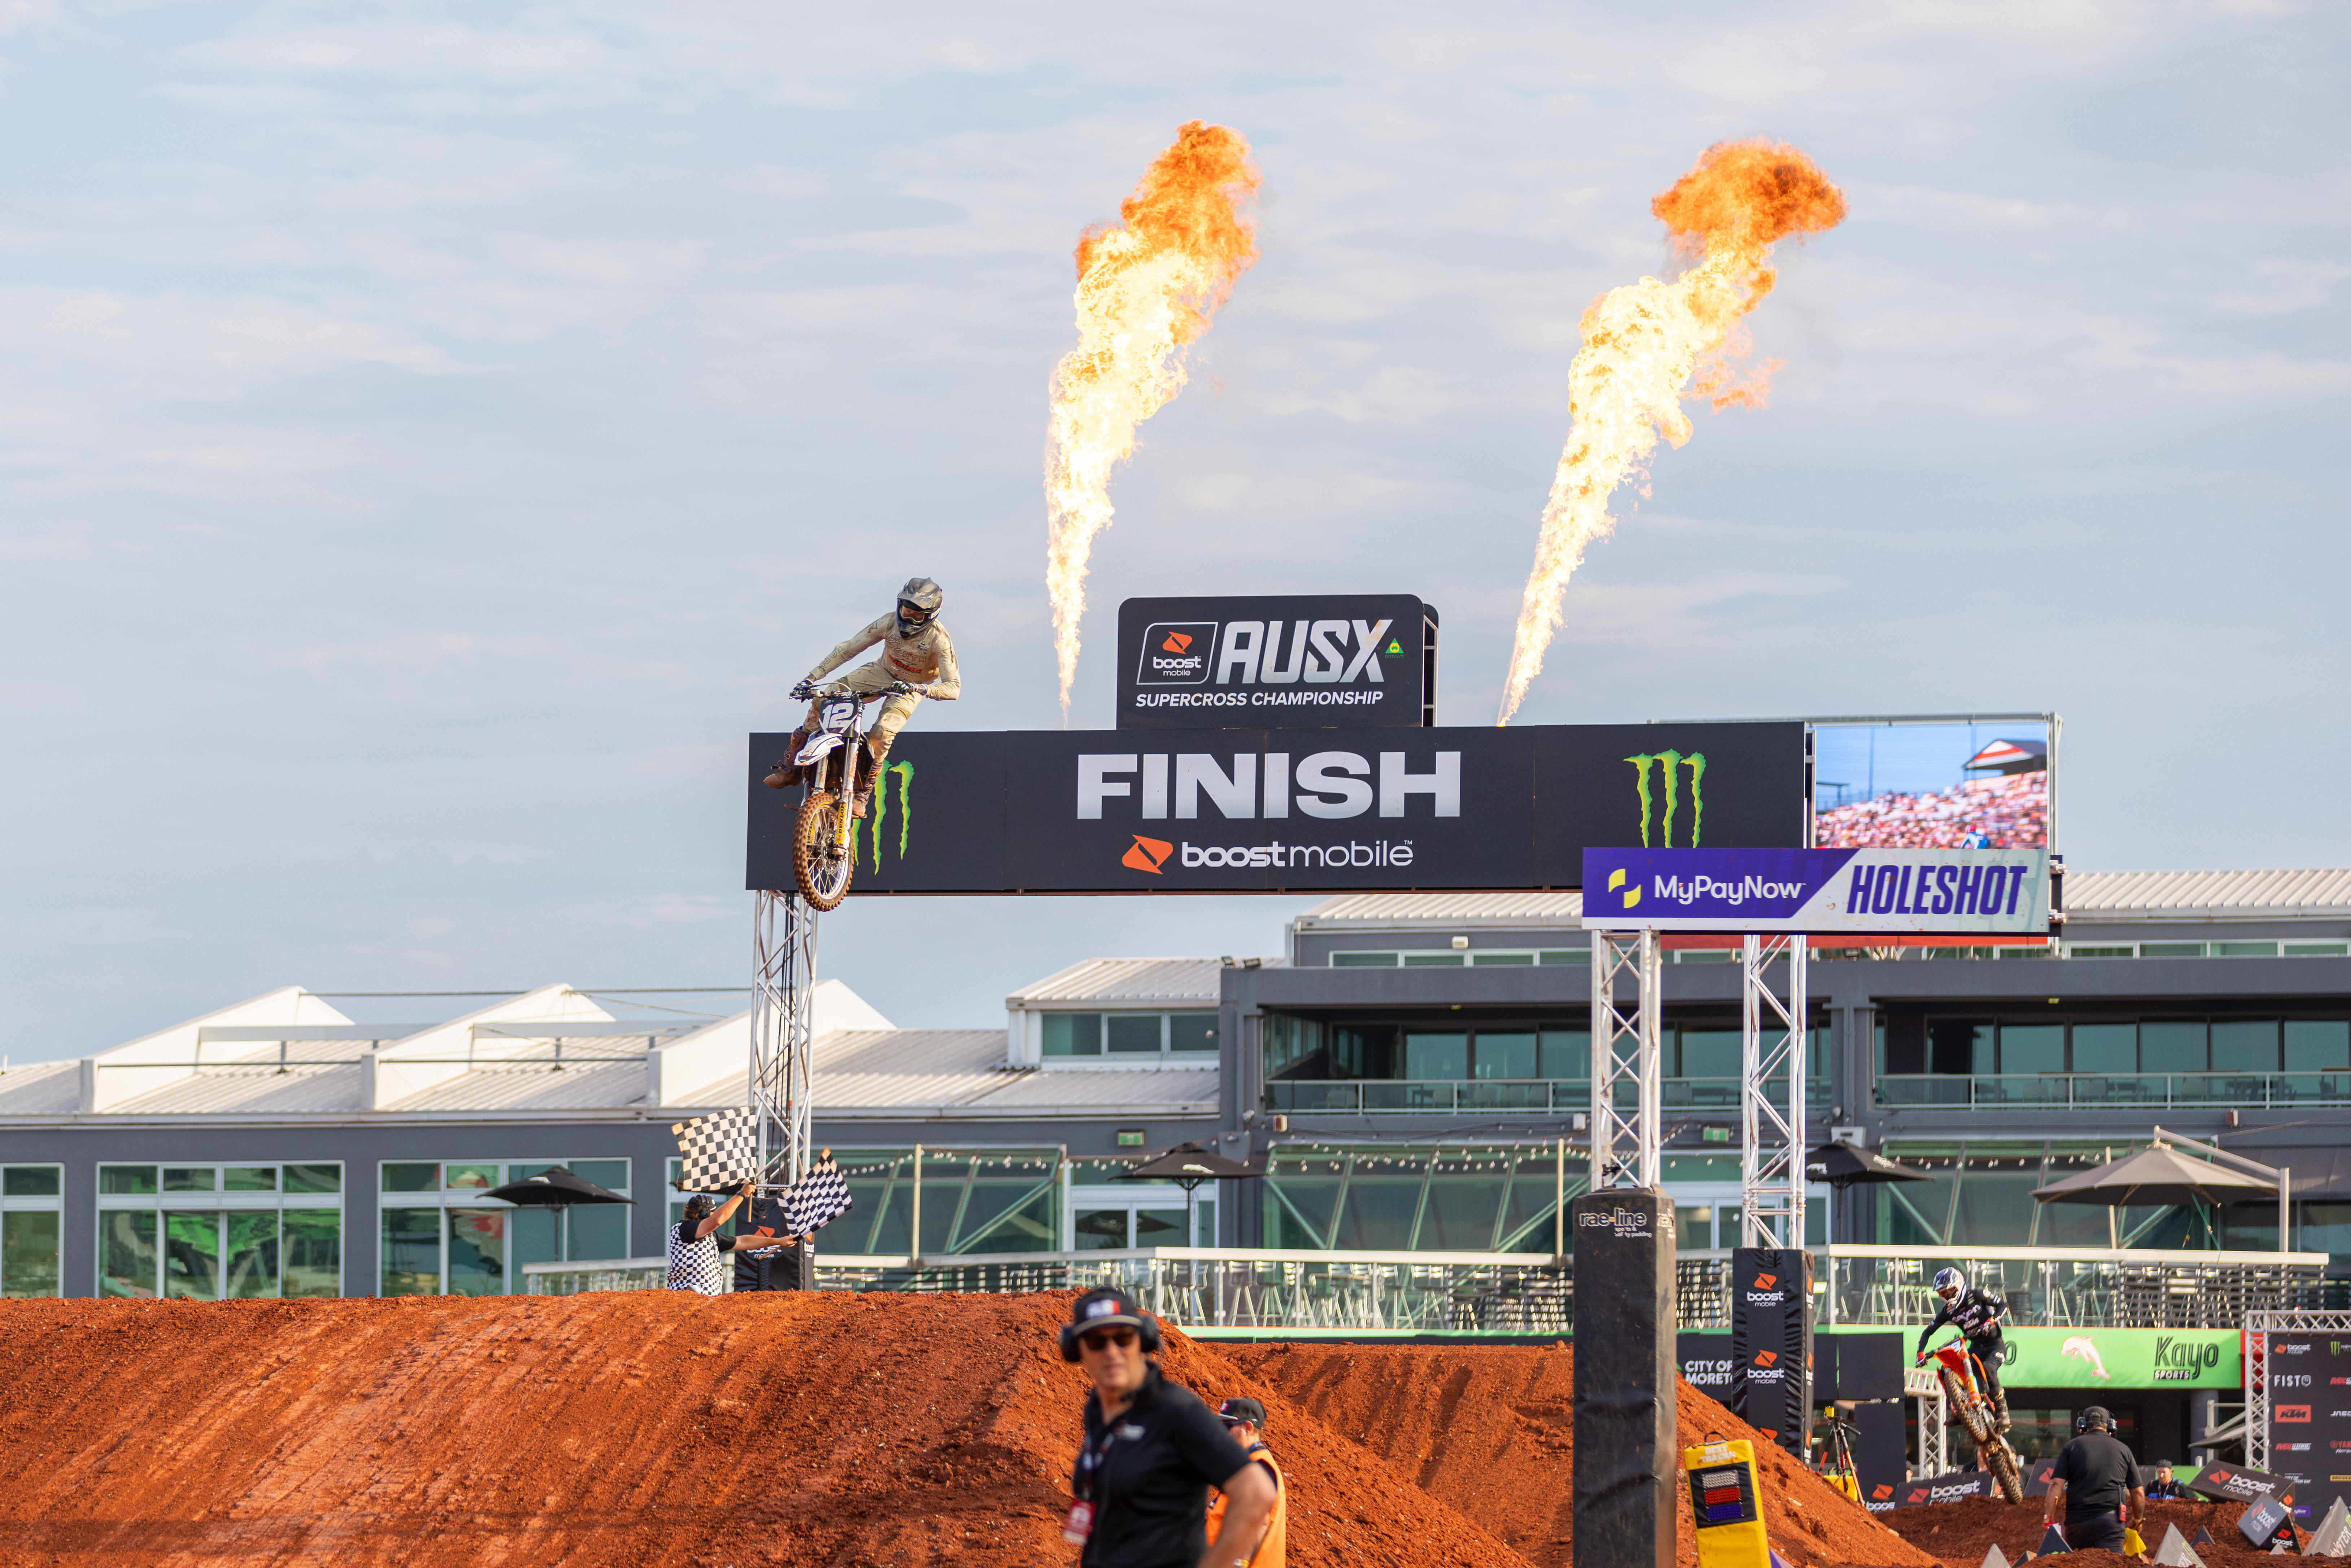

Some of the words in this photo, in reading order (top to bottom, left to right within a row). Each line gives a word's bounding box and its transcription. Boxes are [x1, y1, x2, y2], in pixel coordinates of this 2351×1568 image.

[1216, 619, 1393, 684] AUSX
[1153, 655, 1201, 669] boost
[1136, 693, 1247, 708] SUPERCROSS
[1251, 691, 1383, 706] CHAMPIONSHIP
[822, 703, 854, 728] 12
[1077, 751, 1461, 819] FINISH
[1655, 875, 1802, 905] MyPayNow
[1847, 865, 2028, 915] HOLESHOT
[1579, 1207, 1647, 1227] rae-line
[1747, 1291, 1784, 1301] boost
[2155, 1336, 2219, 1380] Kayo
[1685, 1360, 1715, 1372] CITY
[1716, 1360, 1732, 1372] OF
[1747, 1368, 1784, 1378] boost
[1685, 1372, 1732, 1385] MORET
[2154, 1370, 2190, 1380] SPORTS
[2274, 1375, 2301, 1387] FIST
[2280, 1408, 2307, 1418] KTM
[1705, 1444, 1729, 1455] DIRT
[1931, 1480, 1980, 1499] boost
[2223, 1484, 2253, 1496] mobile
[2229, 1473, 2276, 1494] boost
[1866, 1501, 1896, 1511] boos
[2257, 1507, 2277, 1529] boost
[2272, 1537, 2294, 1547] boost
